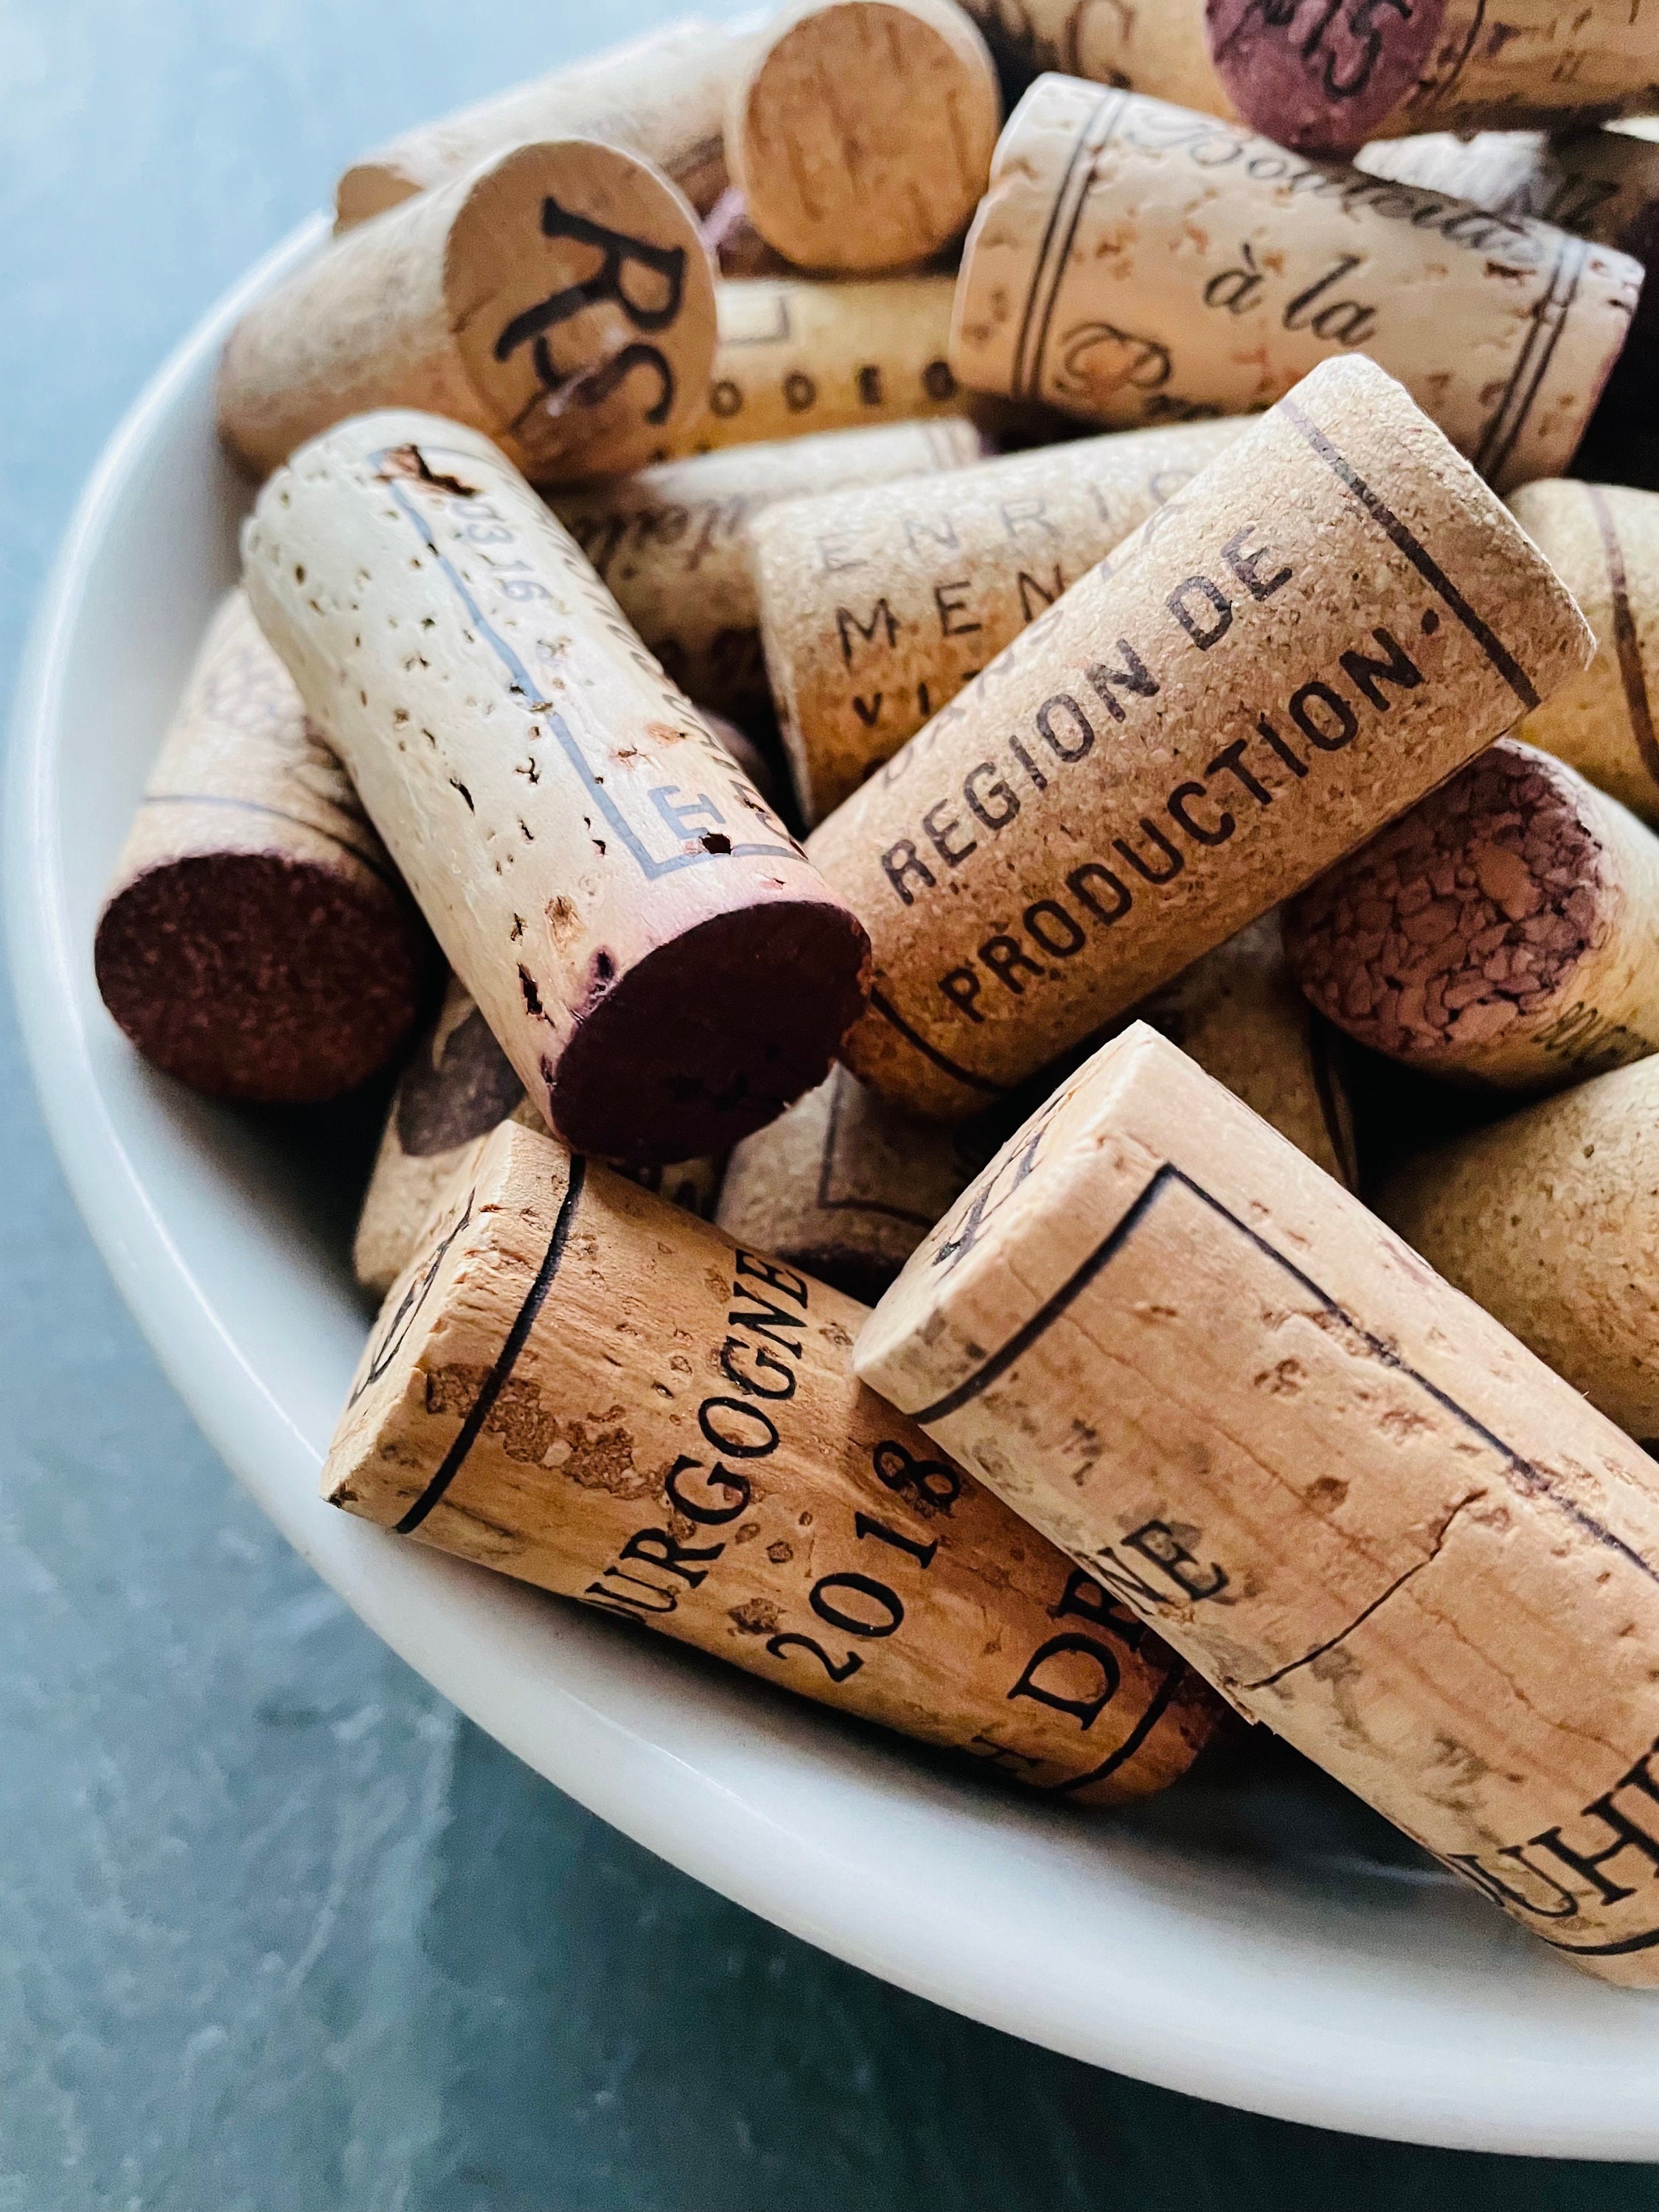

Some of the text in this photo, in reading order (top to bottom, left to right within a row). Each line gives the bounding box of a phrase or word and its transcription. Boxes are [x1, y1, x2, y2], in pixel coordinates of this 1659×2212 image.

[1203, 243, 1377, 347] à la
[835, 563, 1065, 669] MEN
[881, 524, 1292, 905] REGION DE
[579, 1248, 809, 1622] URGOGNE
[765, 1440, 959, 1683] 2018
